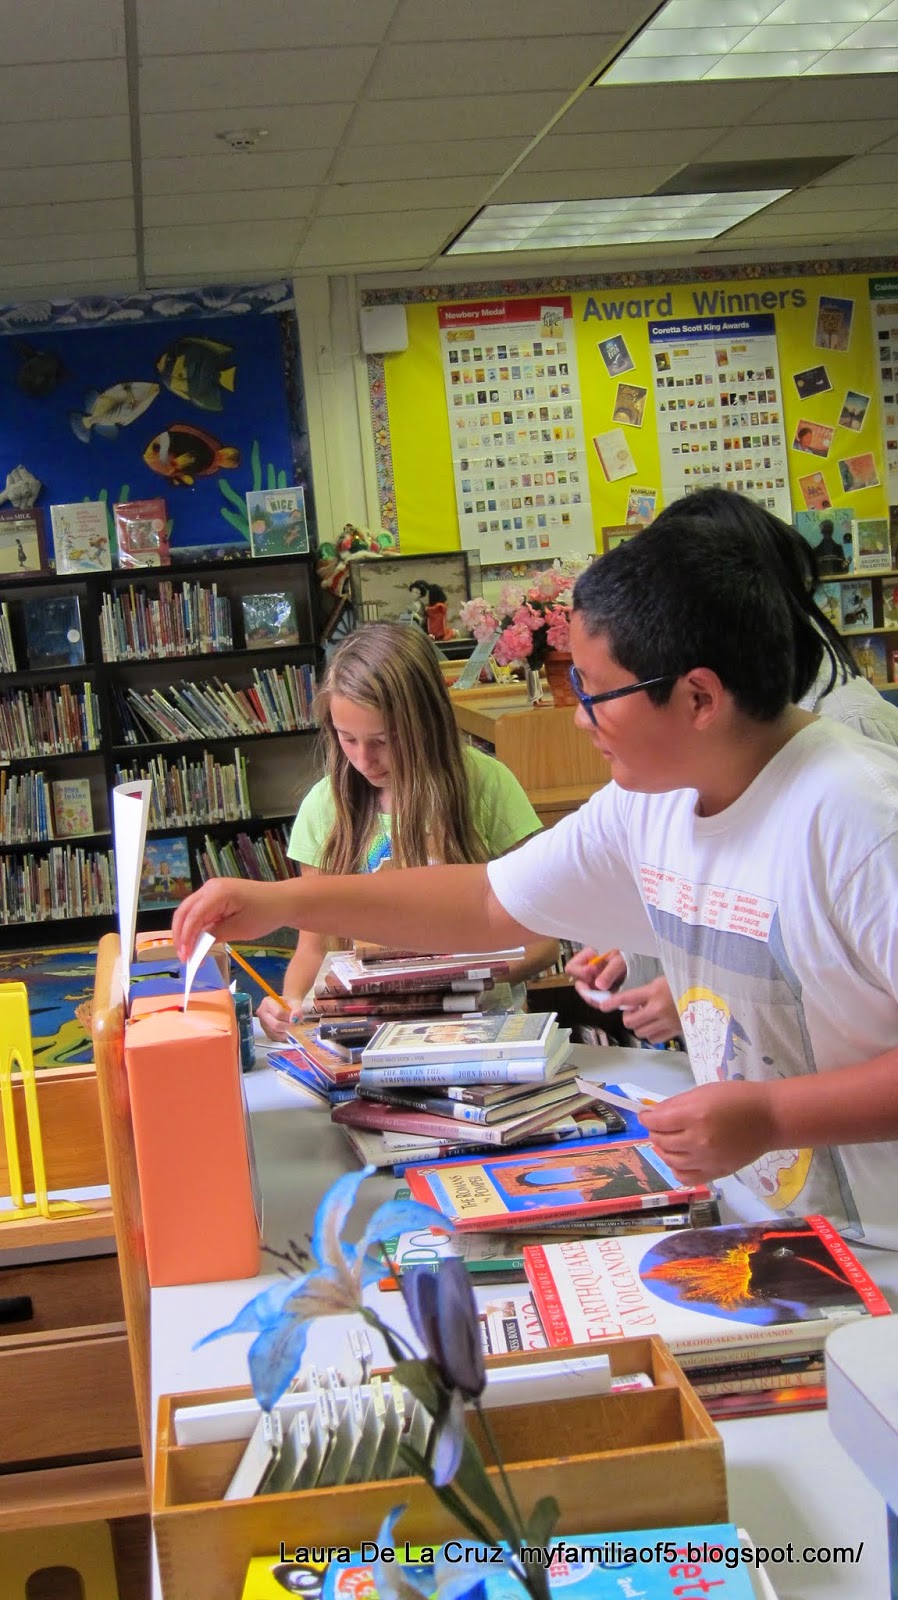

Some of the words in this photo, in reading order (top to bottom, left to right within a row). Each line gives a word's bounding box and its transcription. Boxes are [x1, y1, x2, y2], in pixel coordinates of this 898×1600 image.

[583, 292, 672, 322] Award
[692, 287, 808, 315] Winners
[445, 309, 480, 320] Newbery
[482, 308, 506, 316] Medal
[652, 326, 680, 334] Coretta
[704, 323, 720, 331] King
[722, 321, 750, 330] Awards
[270, 499, 294, 512] NICE
[14, 512, 31, 520] MILK
[744, 917, 760, 926] SAUCE
[749, 929, 768, 938] CREAM
[308, 1005, 338, 1014] AVI
[399, 1068, 413, 1076] BOY
[425, 1067, 441, 1075] THE
[459, 1070, 477, 1078] JOHN
[479, 1069, 501, 1077] BOYNE
[387, 1154, 430, 1164] POLACCO
[449, 1175, 472, 1198] ROMANS
[468, 1176, 491, 1197] POMPEII
[460, 1198, 477, 1210] THE
[812, 1218, 834, 1240] WORLD
[527, 1245, 546, 1269] GUIDES
[830, 1242, 866, 1283] CHANGING
[537, 1272, 556, 1300] NATURE
[558, 1241, 625, 1342] EARTHQUAKES
[861, 1286, 879, 1302] THE
[506, 1322, 518, 1339] BOOKS
[548, 1304, 569, 1344] SCIENCE
[676, 1336, 736, 1348] EARTHQUAKES
[745, 1329, 794, 1340] VOLCANOES
